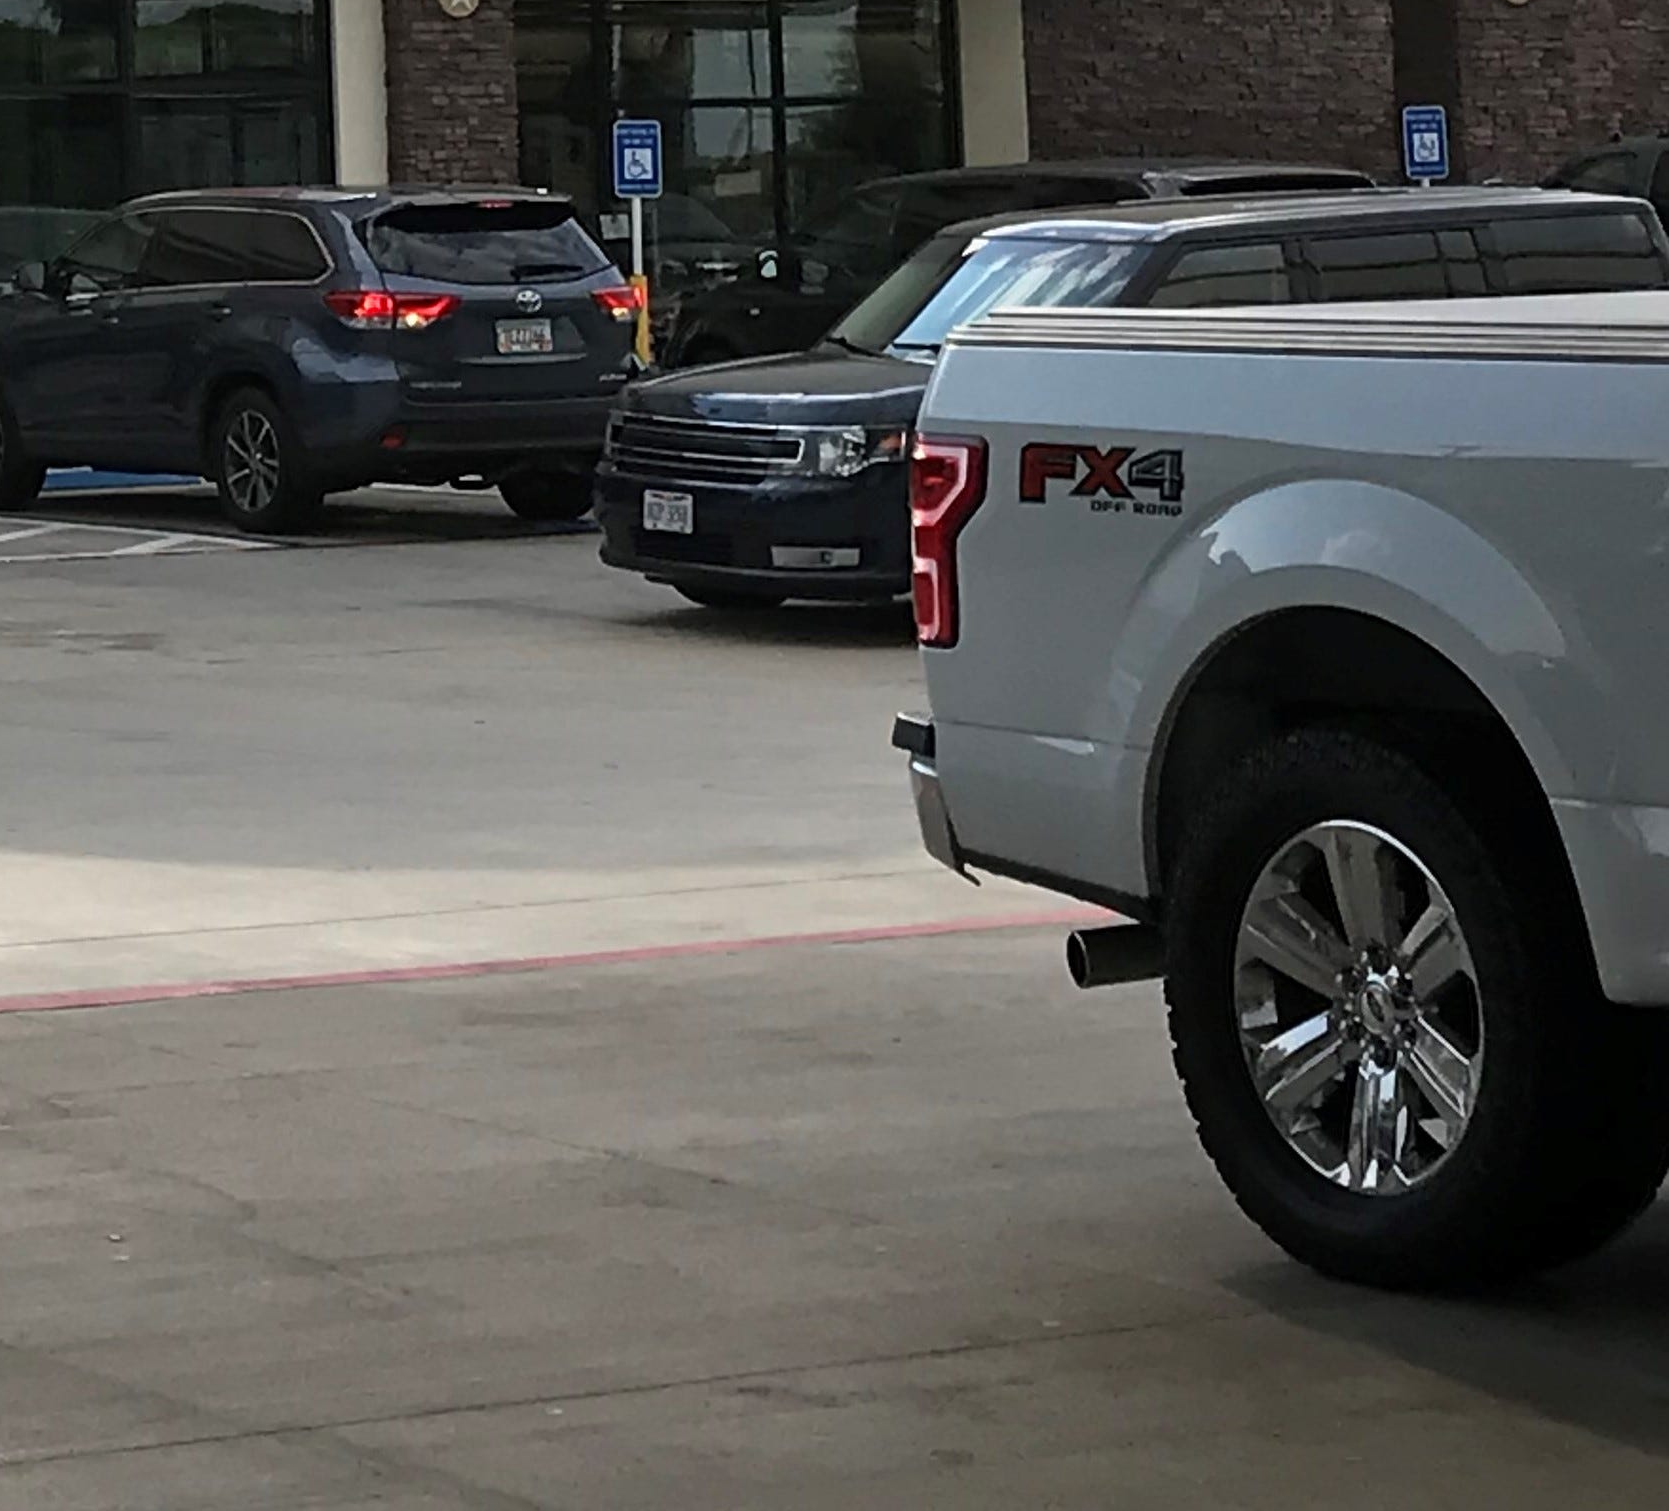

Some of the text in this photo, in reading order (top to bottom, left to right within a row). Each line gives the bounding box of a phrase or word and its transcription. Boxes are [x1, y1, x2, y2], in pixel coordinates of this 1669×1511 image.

[1020, 442, 1185, 503] FX4
[1090, 500, 1183, 517] OFF ROAD
